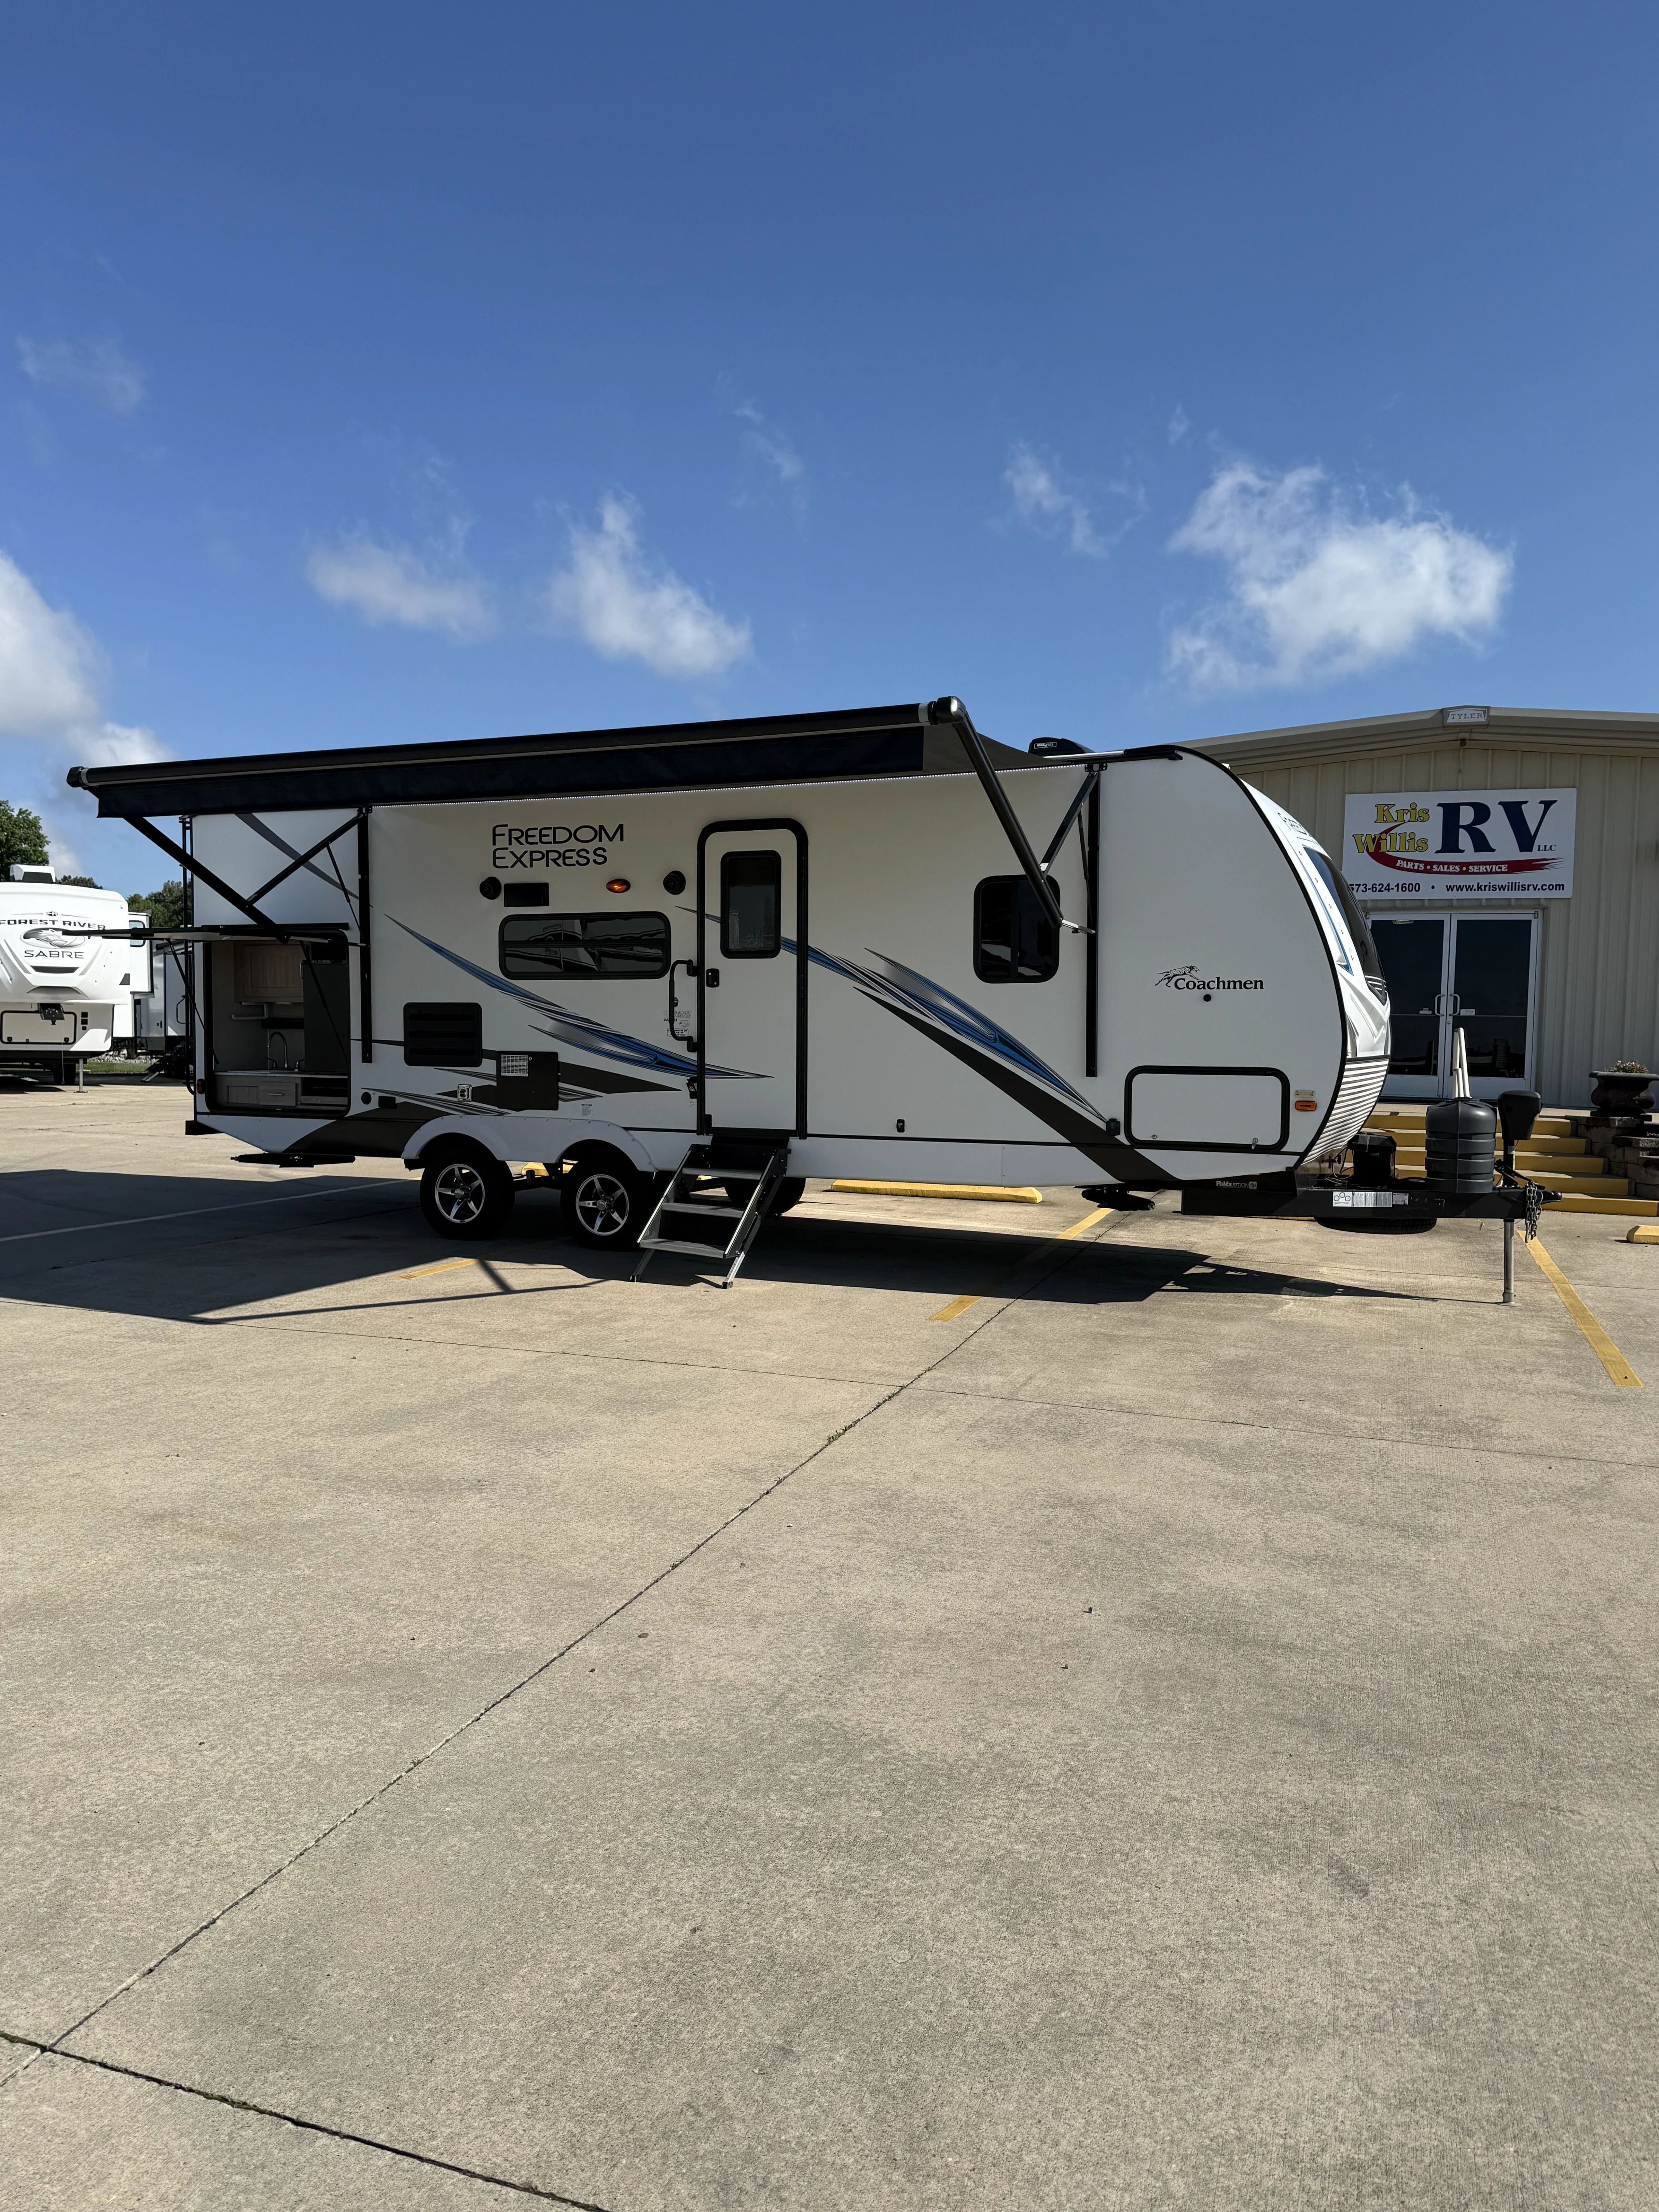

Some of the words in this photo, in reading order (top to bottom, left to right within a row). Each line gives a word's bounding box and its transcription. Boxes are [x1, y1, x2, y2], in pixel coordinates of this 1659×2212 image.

[1374, 802, 1430, 823] Kris
[1435, 800, 1558, 854] RV
[1352, 832, 1428, 853] Willis
[1396, 859, 1424, 870] PARTS
[1446, 882, 1565, 891] www.kriswillisrv.com
[63, 921, 106, 930] RIVER
[24, 950, 84, 959] SABRE
[1174, 977, 1264, 990] Coachmen
